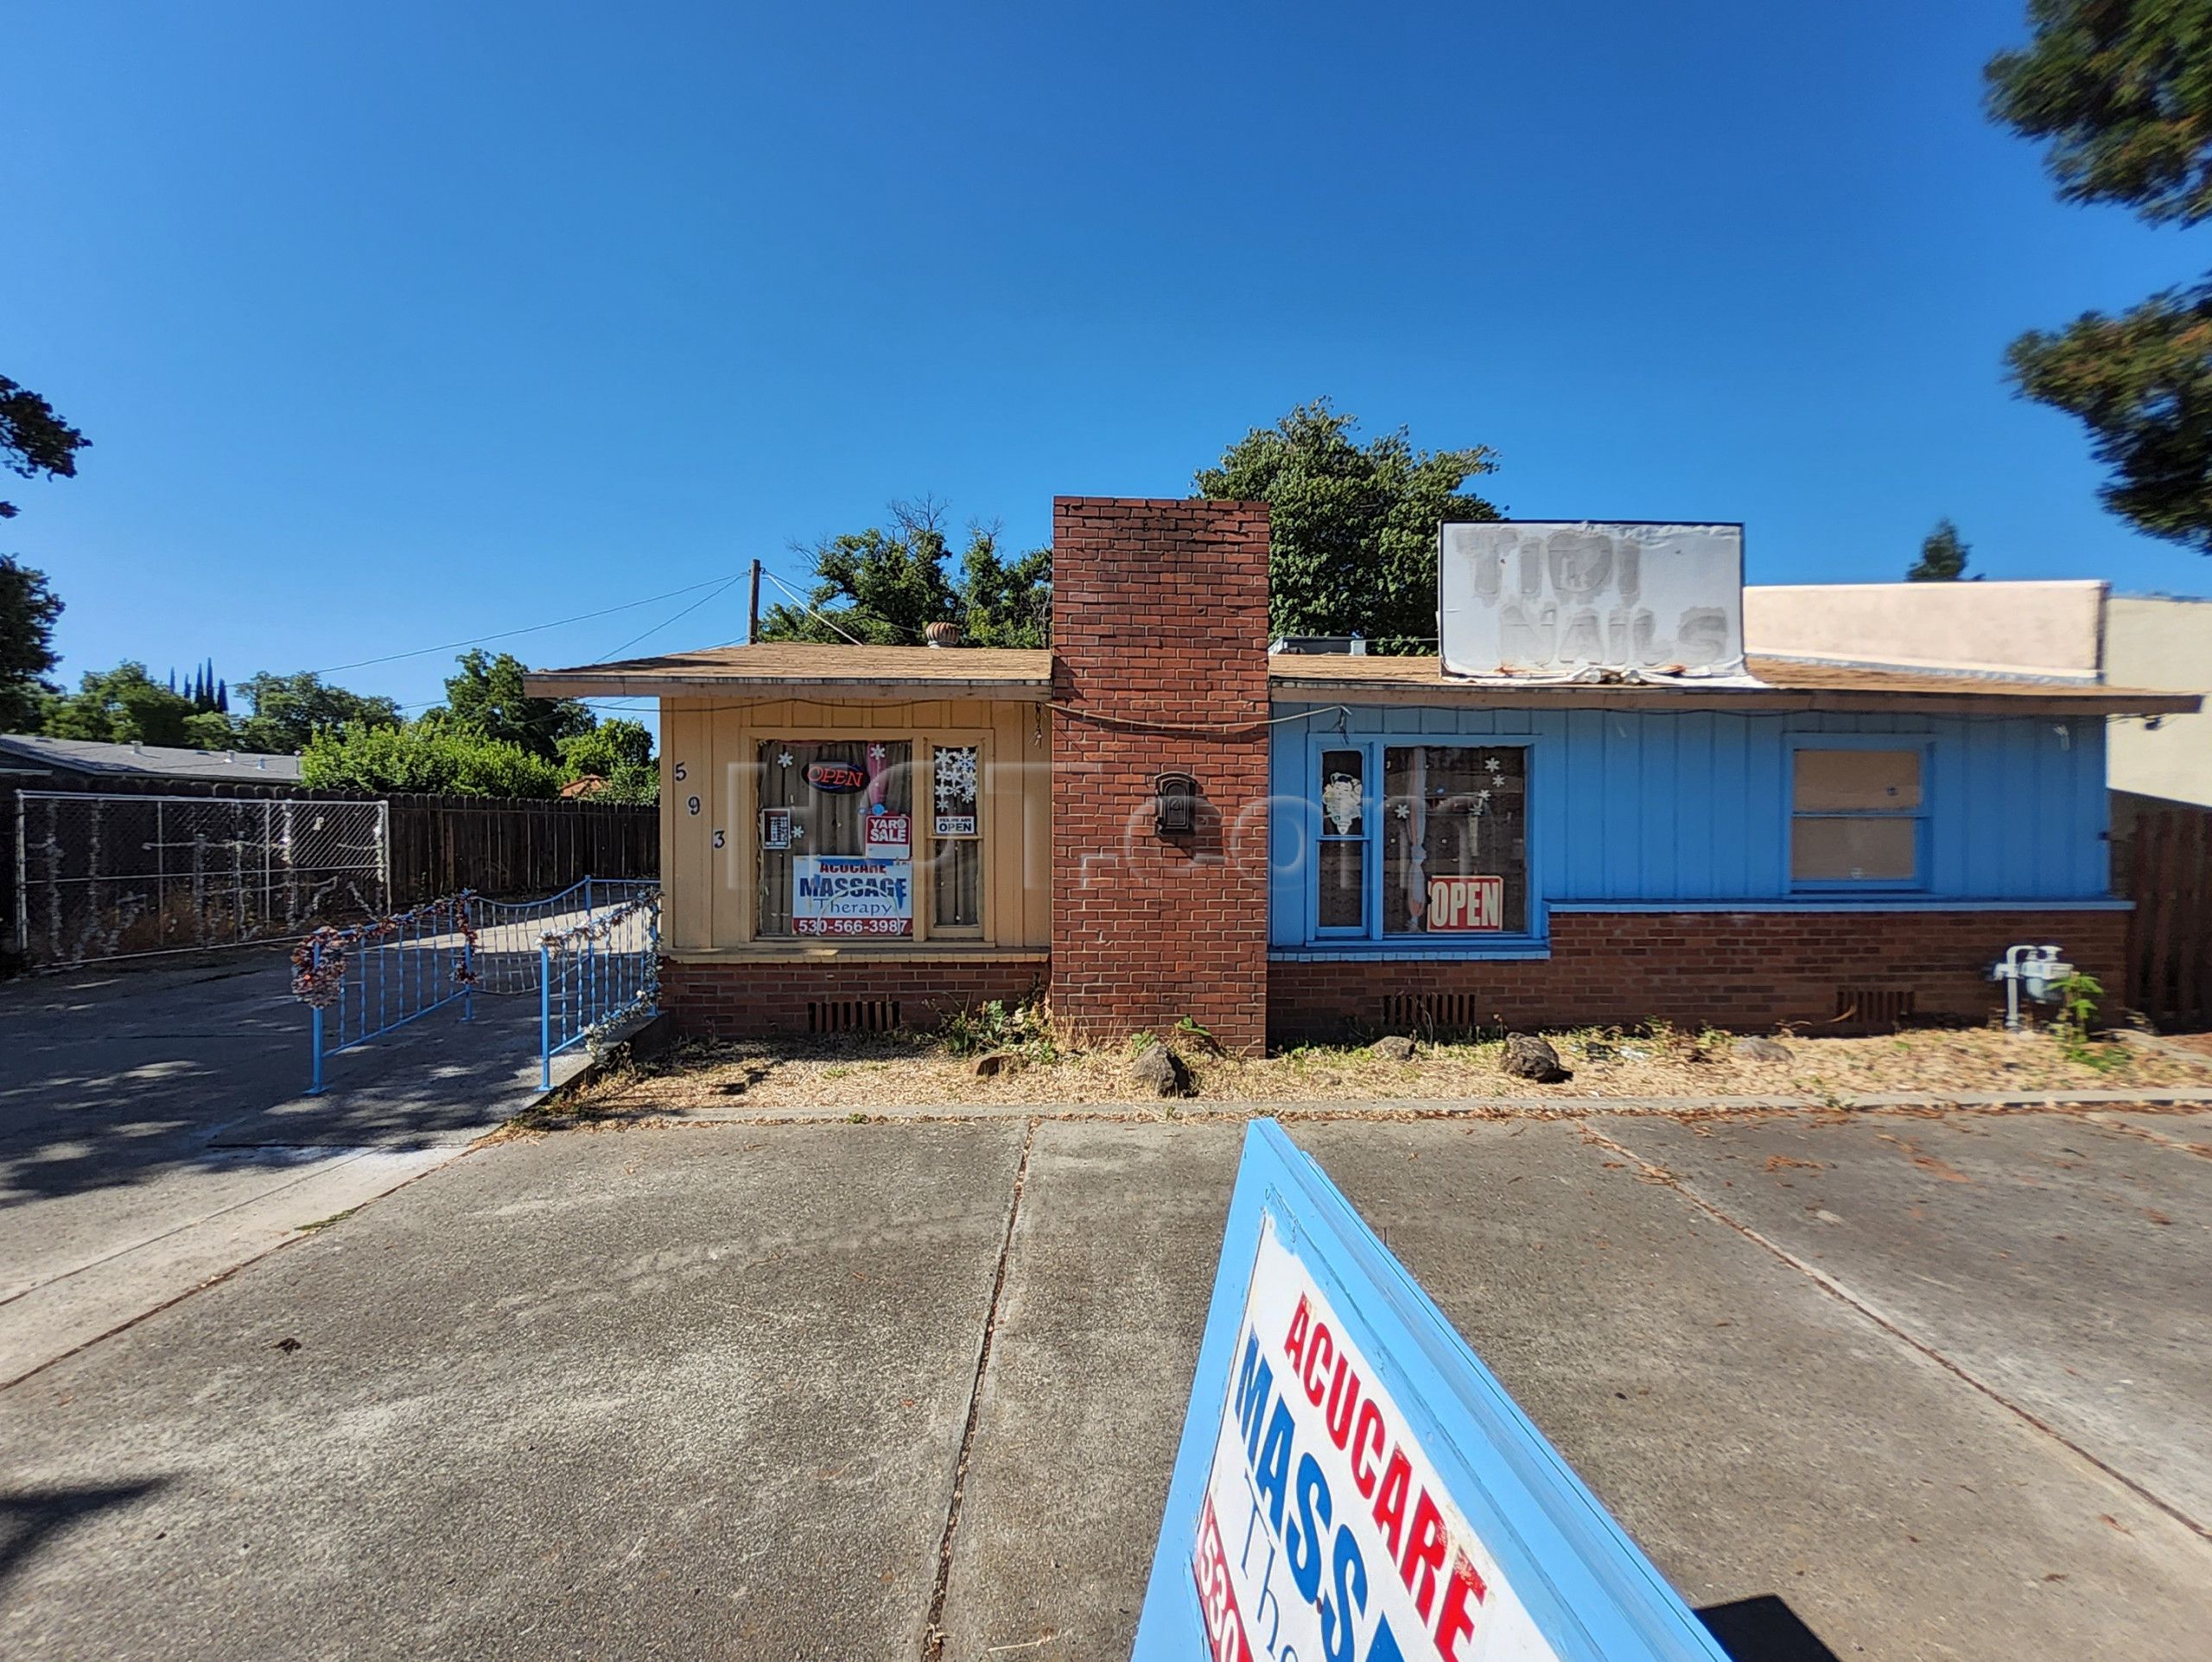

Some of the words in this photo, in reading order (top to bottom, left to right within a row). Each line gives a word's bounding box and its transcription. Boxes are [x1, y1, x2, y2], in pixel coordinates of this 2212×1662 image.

[807, 766, 863, 787] OPEN
[869, 829, 906, 842] SALE
[939, 823, 971, 831] OPEN
[799, 877, 907, 897] MASSAGE
[813, 898, 893, 916] Therapy
[1431, 881, 1499, 927] OPEN
[798, 920, 908, 933] 530-566-3987
[1284, 1291, 1488, 1662] ACUCARE
[1236, 1322, 1407, 1662] MASS
